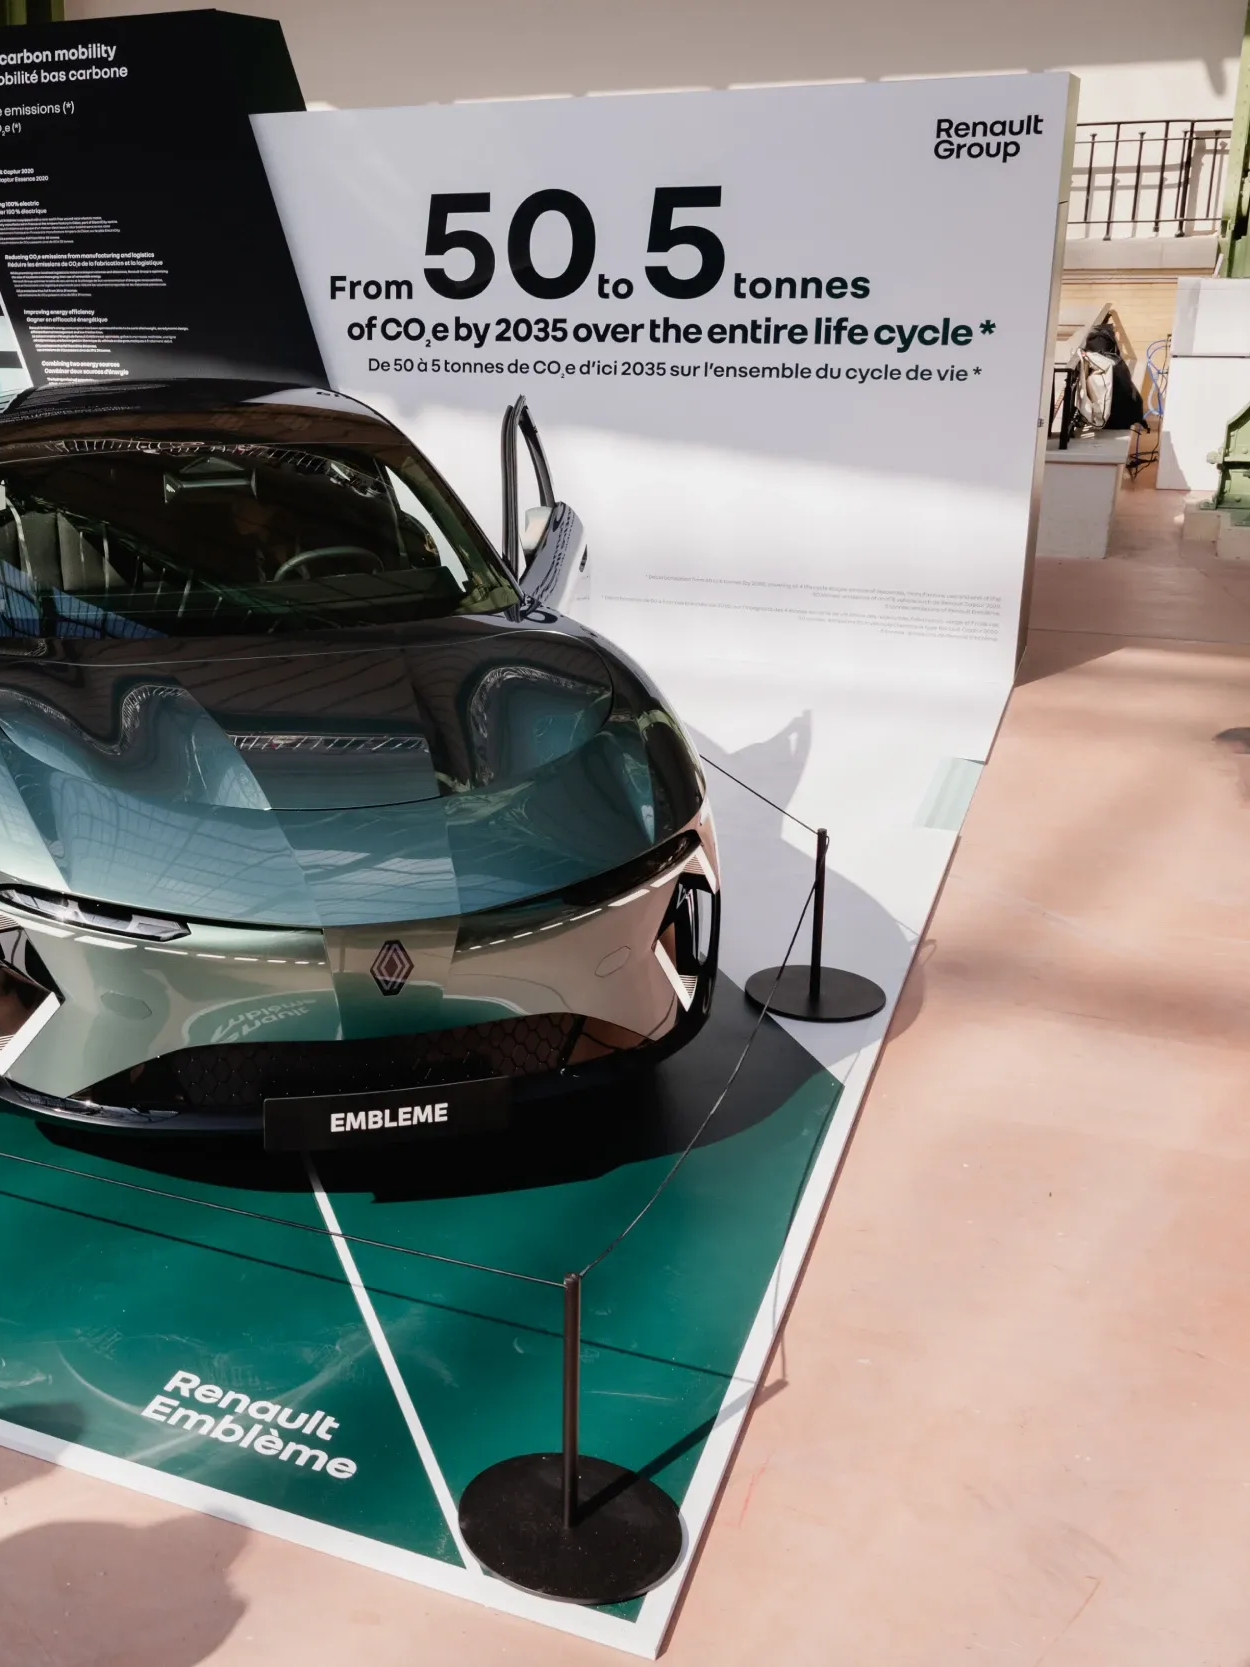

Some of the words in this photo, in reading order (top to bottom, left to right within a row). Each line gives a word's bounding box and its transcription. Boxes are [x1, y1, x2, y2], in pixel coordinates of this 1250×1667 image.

[0, 49, 51, 65] carbon
[55, 43, 116, 61] mobility
[41, 69, 66, 83] bas
[69, 66, 128, 81] carbone
[5, 103, 60, 116] emissions
[936, 114, 1044, 140] Renault
[933, 137, 1021, 164] Group
[330, 275, 413, 300] From
[423, 188, 596, 300] 50
[597, 274, 633, 299] to
[644, 185, 726, 300] 5
[734, 272, 870, 299] tonnes
[347, 316, 377, 341] of
[454, 316, 490, 348] by
[495, 318, 568, 342] 2035
[573, 322, 645, 343] over
[649, 317, 703, 344] the
[707, 317, 808, 345] entire
[814, 317, 868, 345] life
[874, 318, 973, 353] cycle
[368, 358, 390, 372] De
[394, 358, 414, 372] 50
[418, 357, 427, 372] à
[431, 360, 441, 373] 5
[444, 359, 504, 374] tonnes
[507, 360, 530, 374] de
[579, 360, 617, 376] d'ici
[621, 362, 666, 376] 2035
[670, 364, 700, 377] sur
[704, 362, 811, 379] l'ensemble
[815, 363, 841, 379] du
[845, 364, 901, 384] cycle
[905, 364, 932, 381] de
[936, 365, 969, 382] vie
[330, 1102, 448, 1133] EMBLEME
[163, 1370, 340, 1441] Renault
[140, 1394, 358, 1479] Emblème
